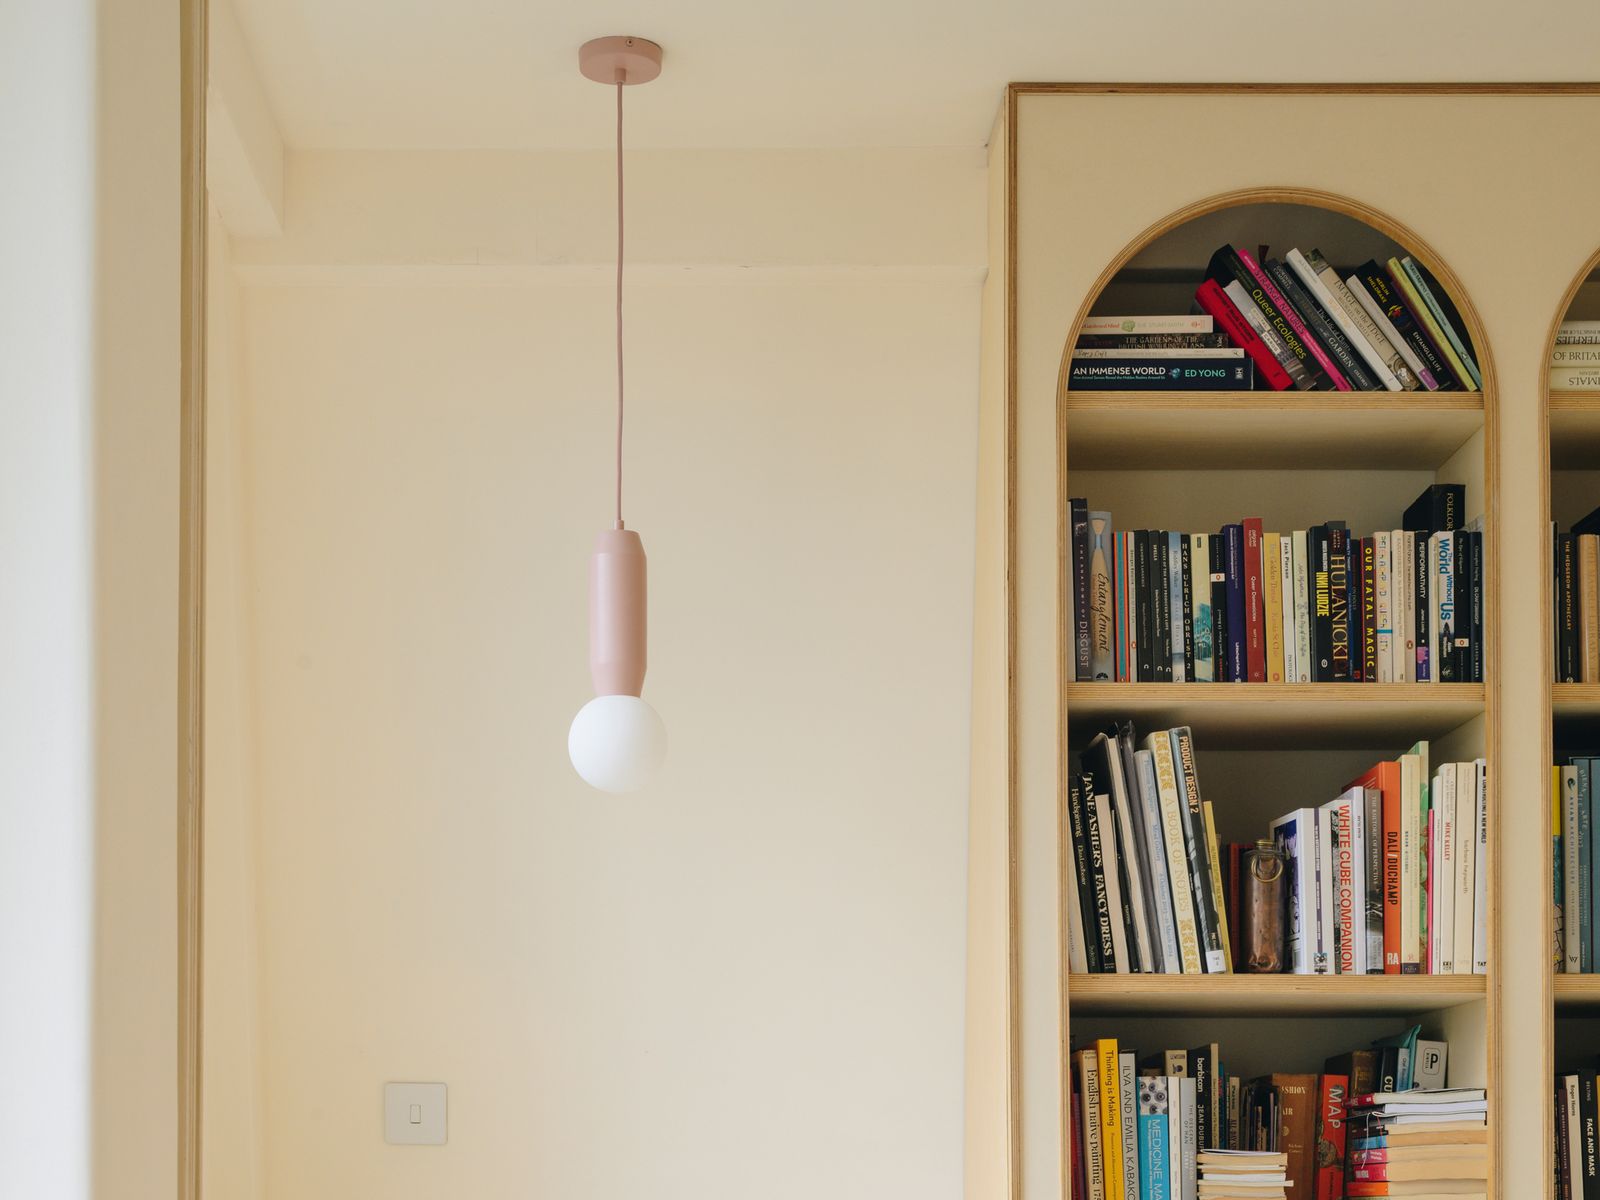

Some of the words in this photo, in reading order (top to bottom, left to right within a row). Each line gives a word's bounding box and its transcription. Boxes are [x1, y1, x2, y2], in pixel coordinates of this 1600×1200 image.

[1253, 267, 1282, 304] STRANGE
[1279, 300, 1306, 336] NATURES
[1366, 275, 1388, 305] SHELDRAKE
[1375, 276, 1391, 296] MERLIN
[1251, 287, 1278, 321] Queer
[1272, 316, 1307, 362] Ecologies
[1334, 278, 1356, 307] IMAGE
[1366, 321, 1387, 347] EDGE
[1327, 335, 1354, 370] GARDEN
[1412, 330, 1435, 362] ENTANGLED
[1431, 360, 1443, 373] LIFE
[1553, 352, 1565, 361] OF
[1073, 367, 1088, 375] AN
[1089, 367, 1130, 375] IMMENSE
[1132, 367, 1166, 375] WORLD
[1184, 369, 1196, 378] ED
[1197, 369, 1226, 378] YONG
[1446, 492, 1454, 532] FOLKLOR
[1365, 547, 1373, 571] OUR
[1439, 538, 1451, 574] World
[1316, 572, 1329, 588] INNI
[1446, 574, 1454, 602] Without
[1091, 573, 1111, 653] Entanglement
[1316, 589, 1329, 617] LUDZIE
[1330, 555, 1348, 662] HULANICKI
[1441, 602, 1454, 620] Us
[1080, 621, 1089, 668] DISGUST
[1367, 627, 1375, 667] MAGIC
[1180, 736, 1194, 774] PRODUCT
[1082, 772, 1096, 810] 'JANE
[1165, 797, 1175, 805] A
[1185, 776, 1198, 806] DESIGN
[1088, 813, 1102, 867] ASHER'S
[1167, 811, 1180, 846] BOOK
[1339, 804, 1351, 848] WHITE
[1152, 840, 1162, 861] Gallery
[1172, 849, 1184, 864] OF
[1339, 851, 1351, 885] CUBE
[1387, 831, 1399, 905] DALÍ/DUCHAMP
[1094, 874, 1107, 915] FANCY
[1175, 869, 1189, 912] NOTES
[1462, 864, 1470, 894] hepworth
[1101, 917, 1113, 956] DRESS
[1340, 889, 1352, 971] COMPANION
[1386, 952, 1399, 965] RA
[1105, 1050, 1115, 1086] Thinking
[1123, 1065, 1131, 1086] ILYA
[1197, 1057, 1205, 1092] barbican
[1087, 1069, 1100, 1108] English
[1124, 1090, 1132, 1114] AND
[1089, 1111, 1101, 1139] naive
[1106, 1099, 1116, 1126] Making
[1328, 1088, 1342, 1129] MAP
[1125, 1117, 1134, 1153] EMILIA
[1152, 1119, 1163, 1182] MEDICINE
[1089, 1141, 1102, 1185] painting
